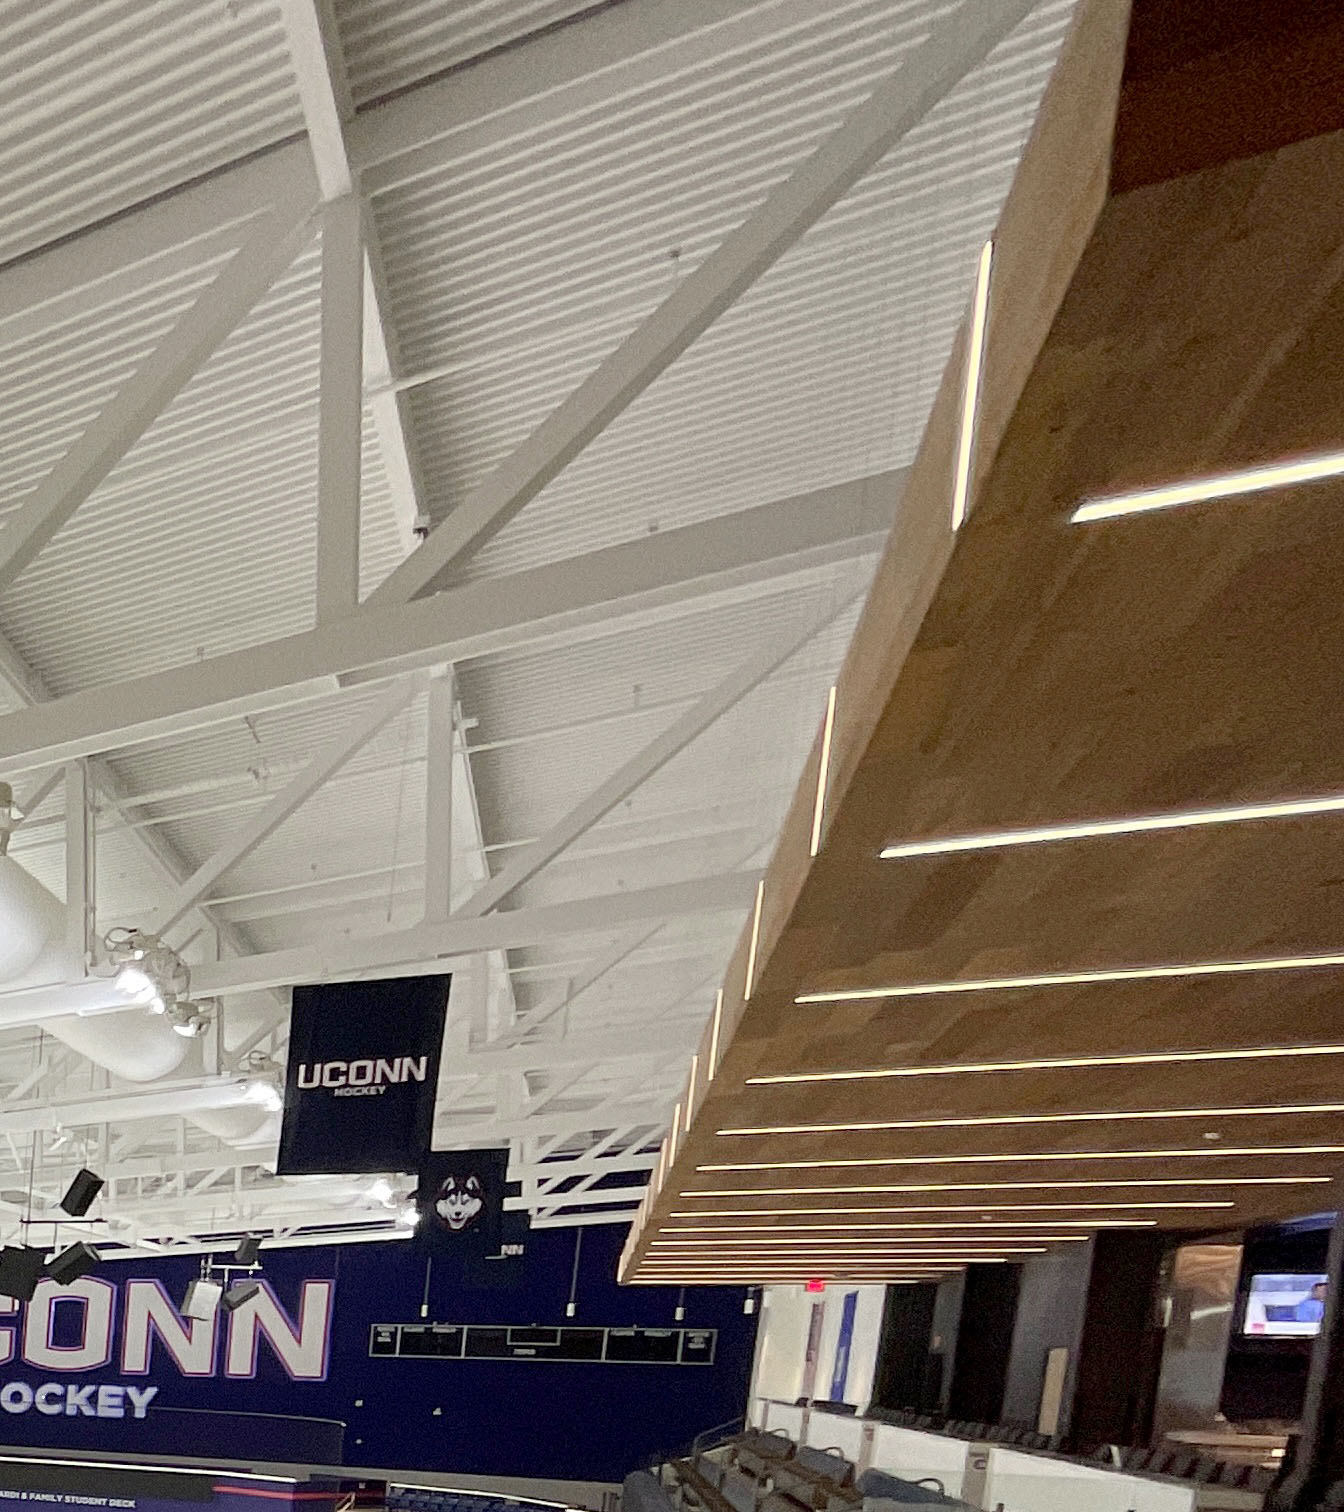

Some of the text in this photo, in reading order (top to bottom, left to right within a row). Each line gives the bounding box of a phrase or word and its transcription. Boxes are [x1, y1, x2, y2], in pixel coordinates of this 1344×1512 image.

[297, 1056, 428, 1089] UCONN
[334, 1085, 386, 1097] HOCKEY
[29, 1492, 64, 1503] FAMILY
[64, 1494, 109, 1507] STUDENT
[109, 1498, 136, 1509] DECK
